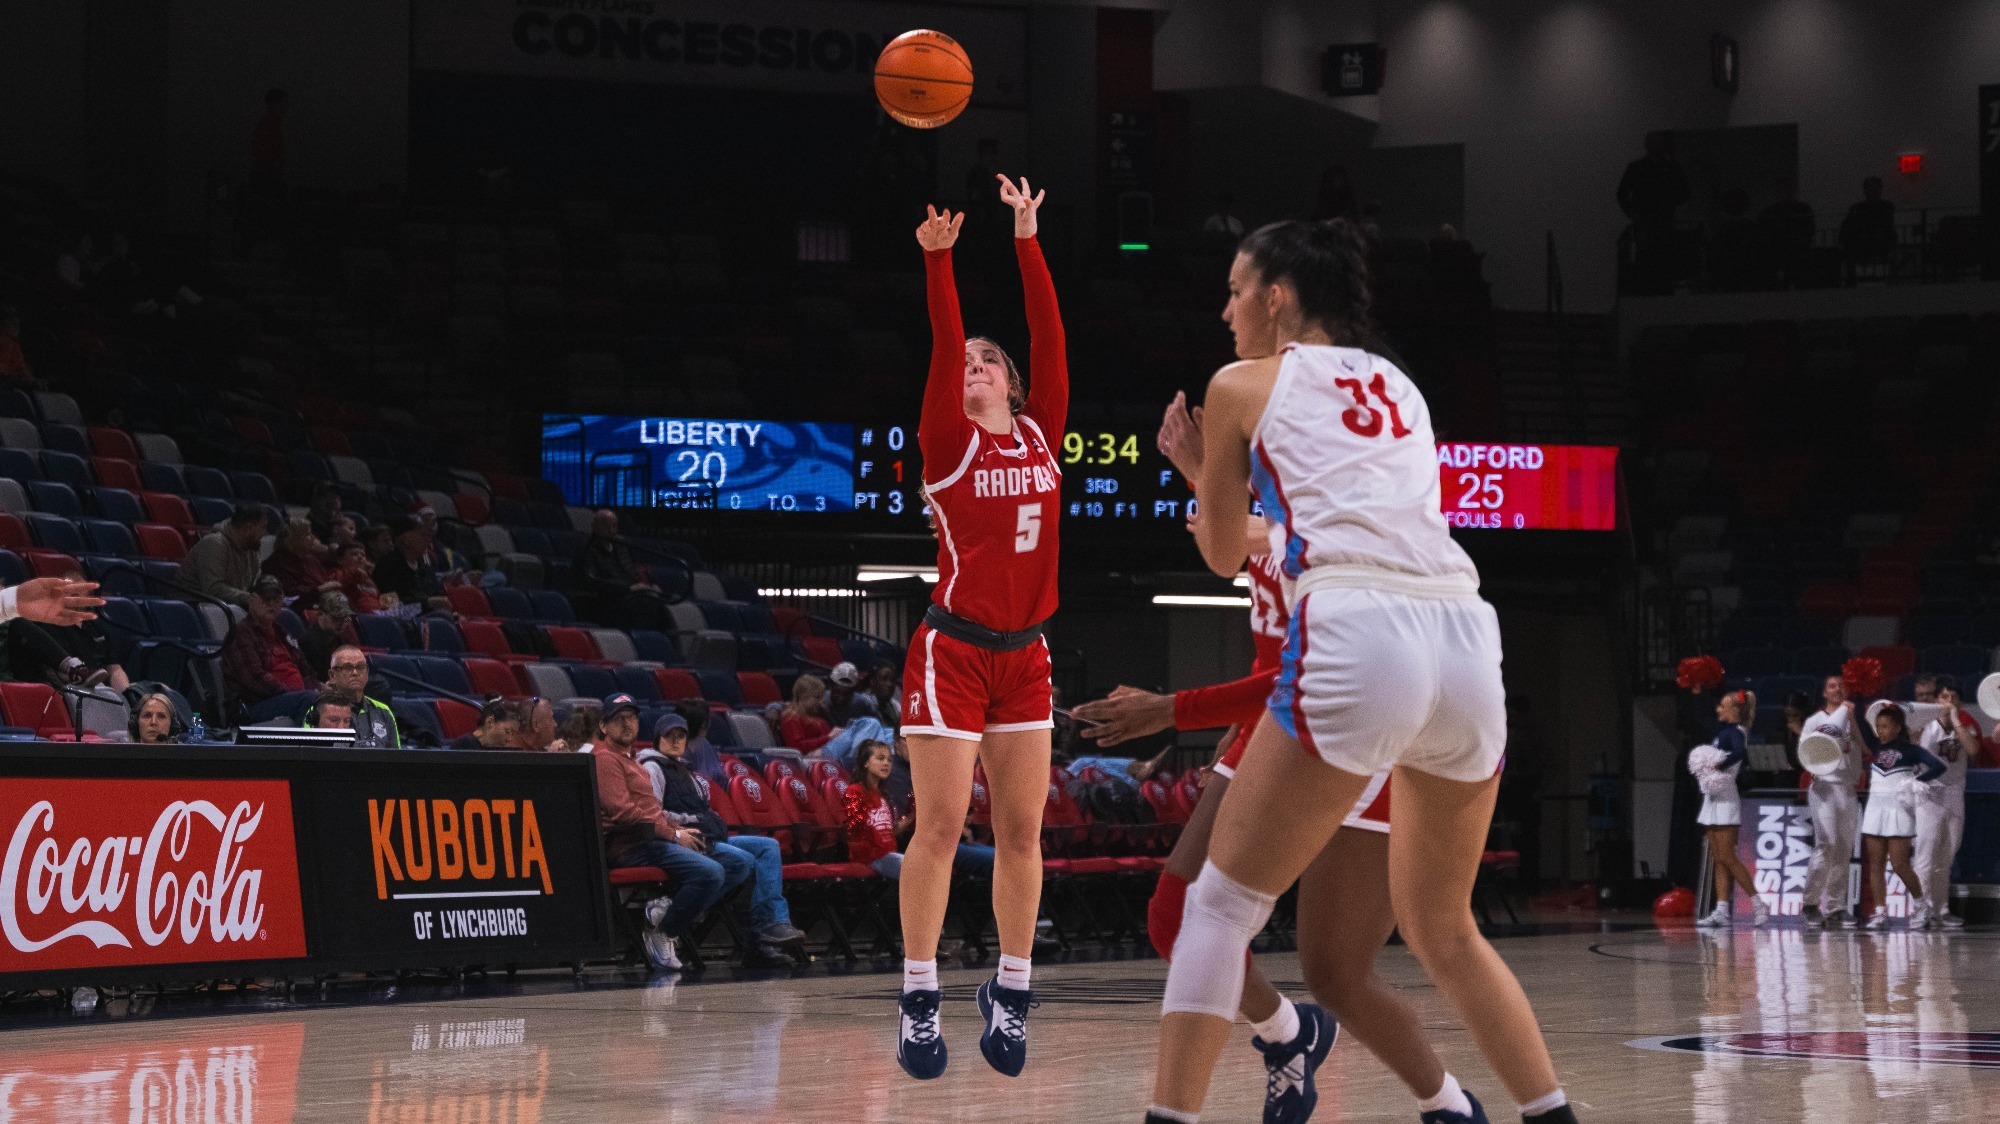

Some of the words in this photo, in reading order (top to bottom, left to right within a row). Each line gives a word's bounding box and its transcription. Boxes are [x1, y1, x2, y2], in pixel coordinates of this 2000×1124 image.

[640, 420, 761, 447] LIBERTY
[861, 429, 873, 446] #
[888, 427, 904, 450] 0
[1063, 432, 1140, 464] 9:34
[1436, 445, 1544, 470] ADFORD
[677, 450, 727, 488] 20
[861, 461, 873, 478] F
[893, 460, 903, 482] 1
[1160, 470, 1172, 487] F
[1085, 477, 1118, 493] 3RD
[1458, 472, 1504, 509] 25
[730, 493, 741, 509] 0
[815, 496, 826, 511] 3
[854, 492, 880, 509] PT
[888, 490, 904, 514] 3
[1154, 500, 1179, 518] PT
[1015, 502, 1042, 553] 5
[1446, 512, 1502, 529] FOULS
[1514, 513, 1525, 529] 0
[368, 799, 554, 899] KUBOTA
[1753, 806, 1785, 915] NOISE
[1781, 806, 1814, 915] MAKE
[0, 800, 264, 952] Coca-Cola
[413, 911, 433, 939] OF
[440, 908, 527, 939] LYNCHBURG
